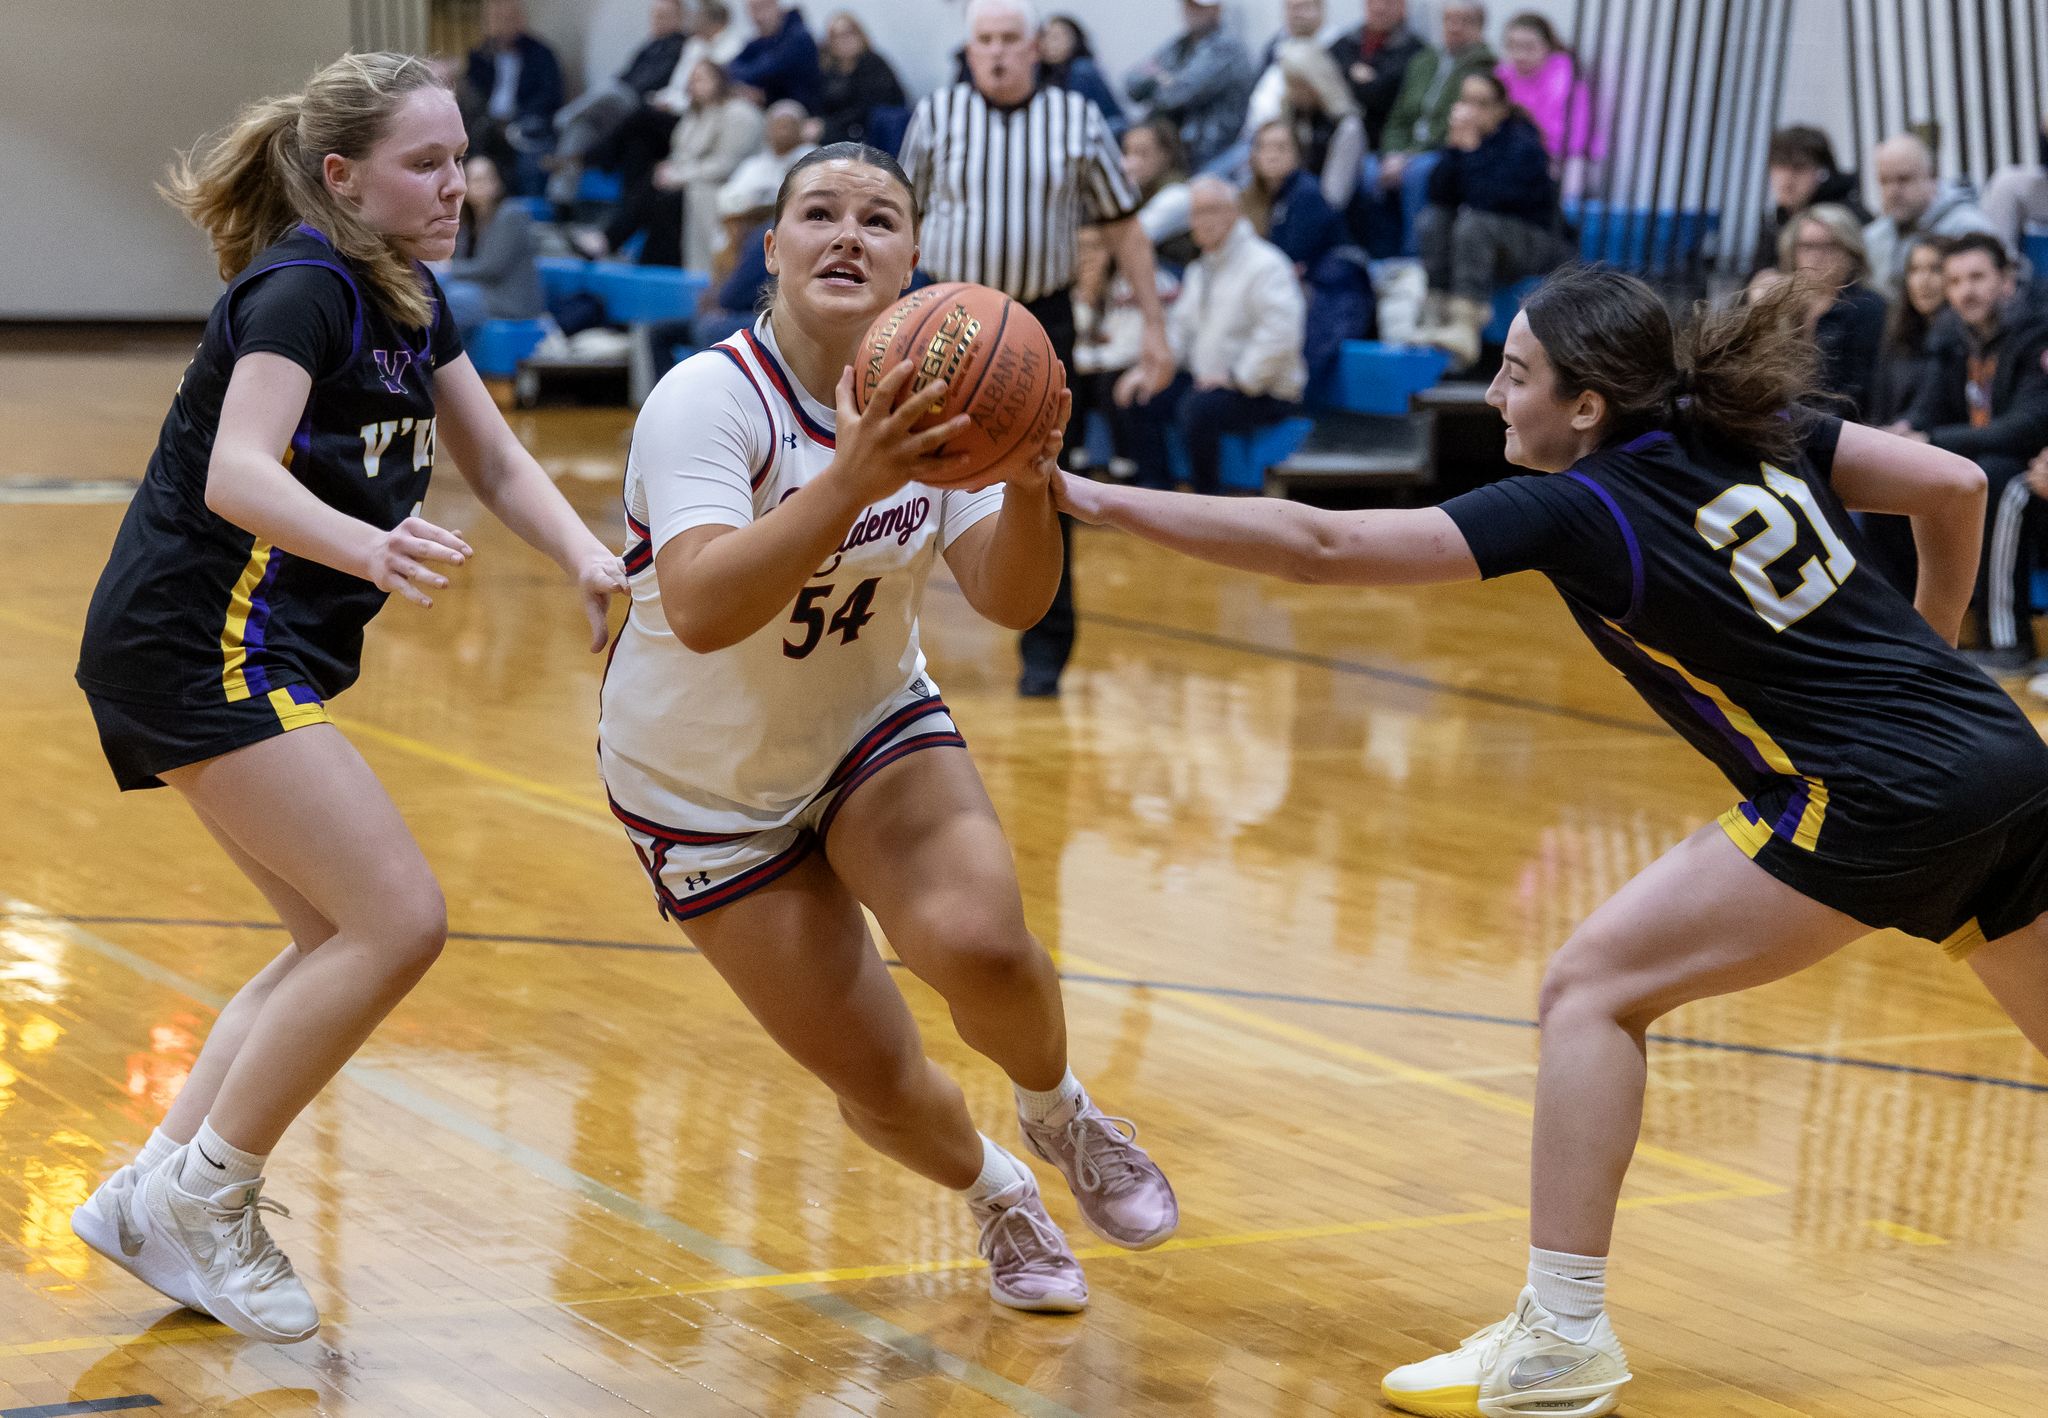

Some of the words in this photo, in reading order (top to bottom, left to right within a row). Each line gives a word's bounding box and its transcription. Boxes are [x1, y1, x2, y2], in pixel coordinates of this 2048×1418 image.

[911, 302, 971, 395] EGACY
[970, 344, 1021, 428] ALBANY
[985, 343, 1042, 444] ACADEMY
[1694, 460, 1857, 633] 21
[782, 577, 883, 660] 54
